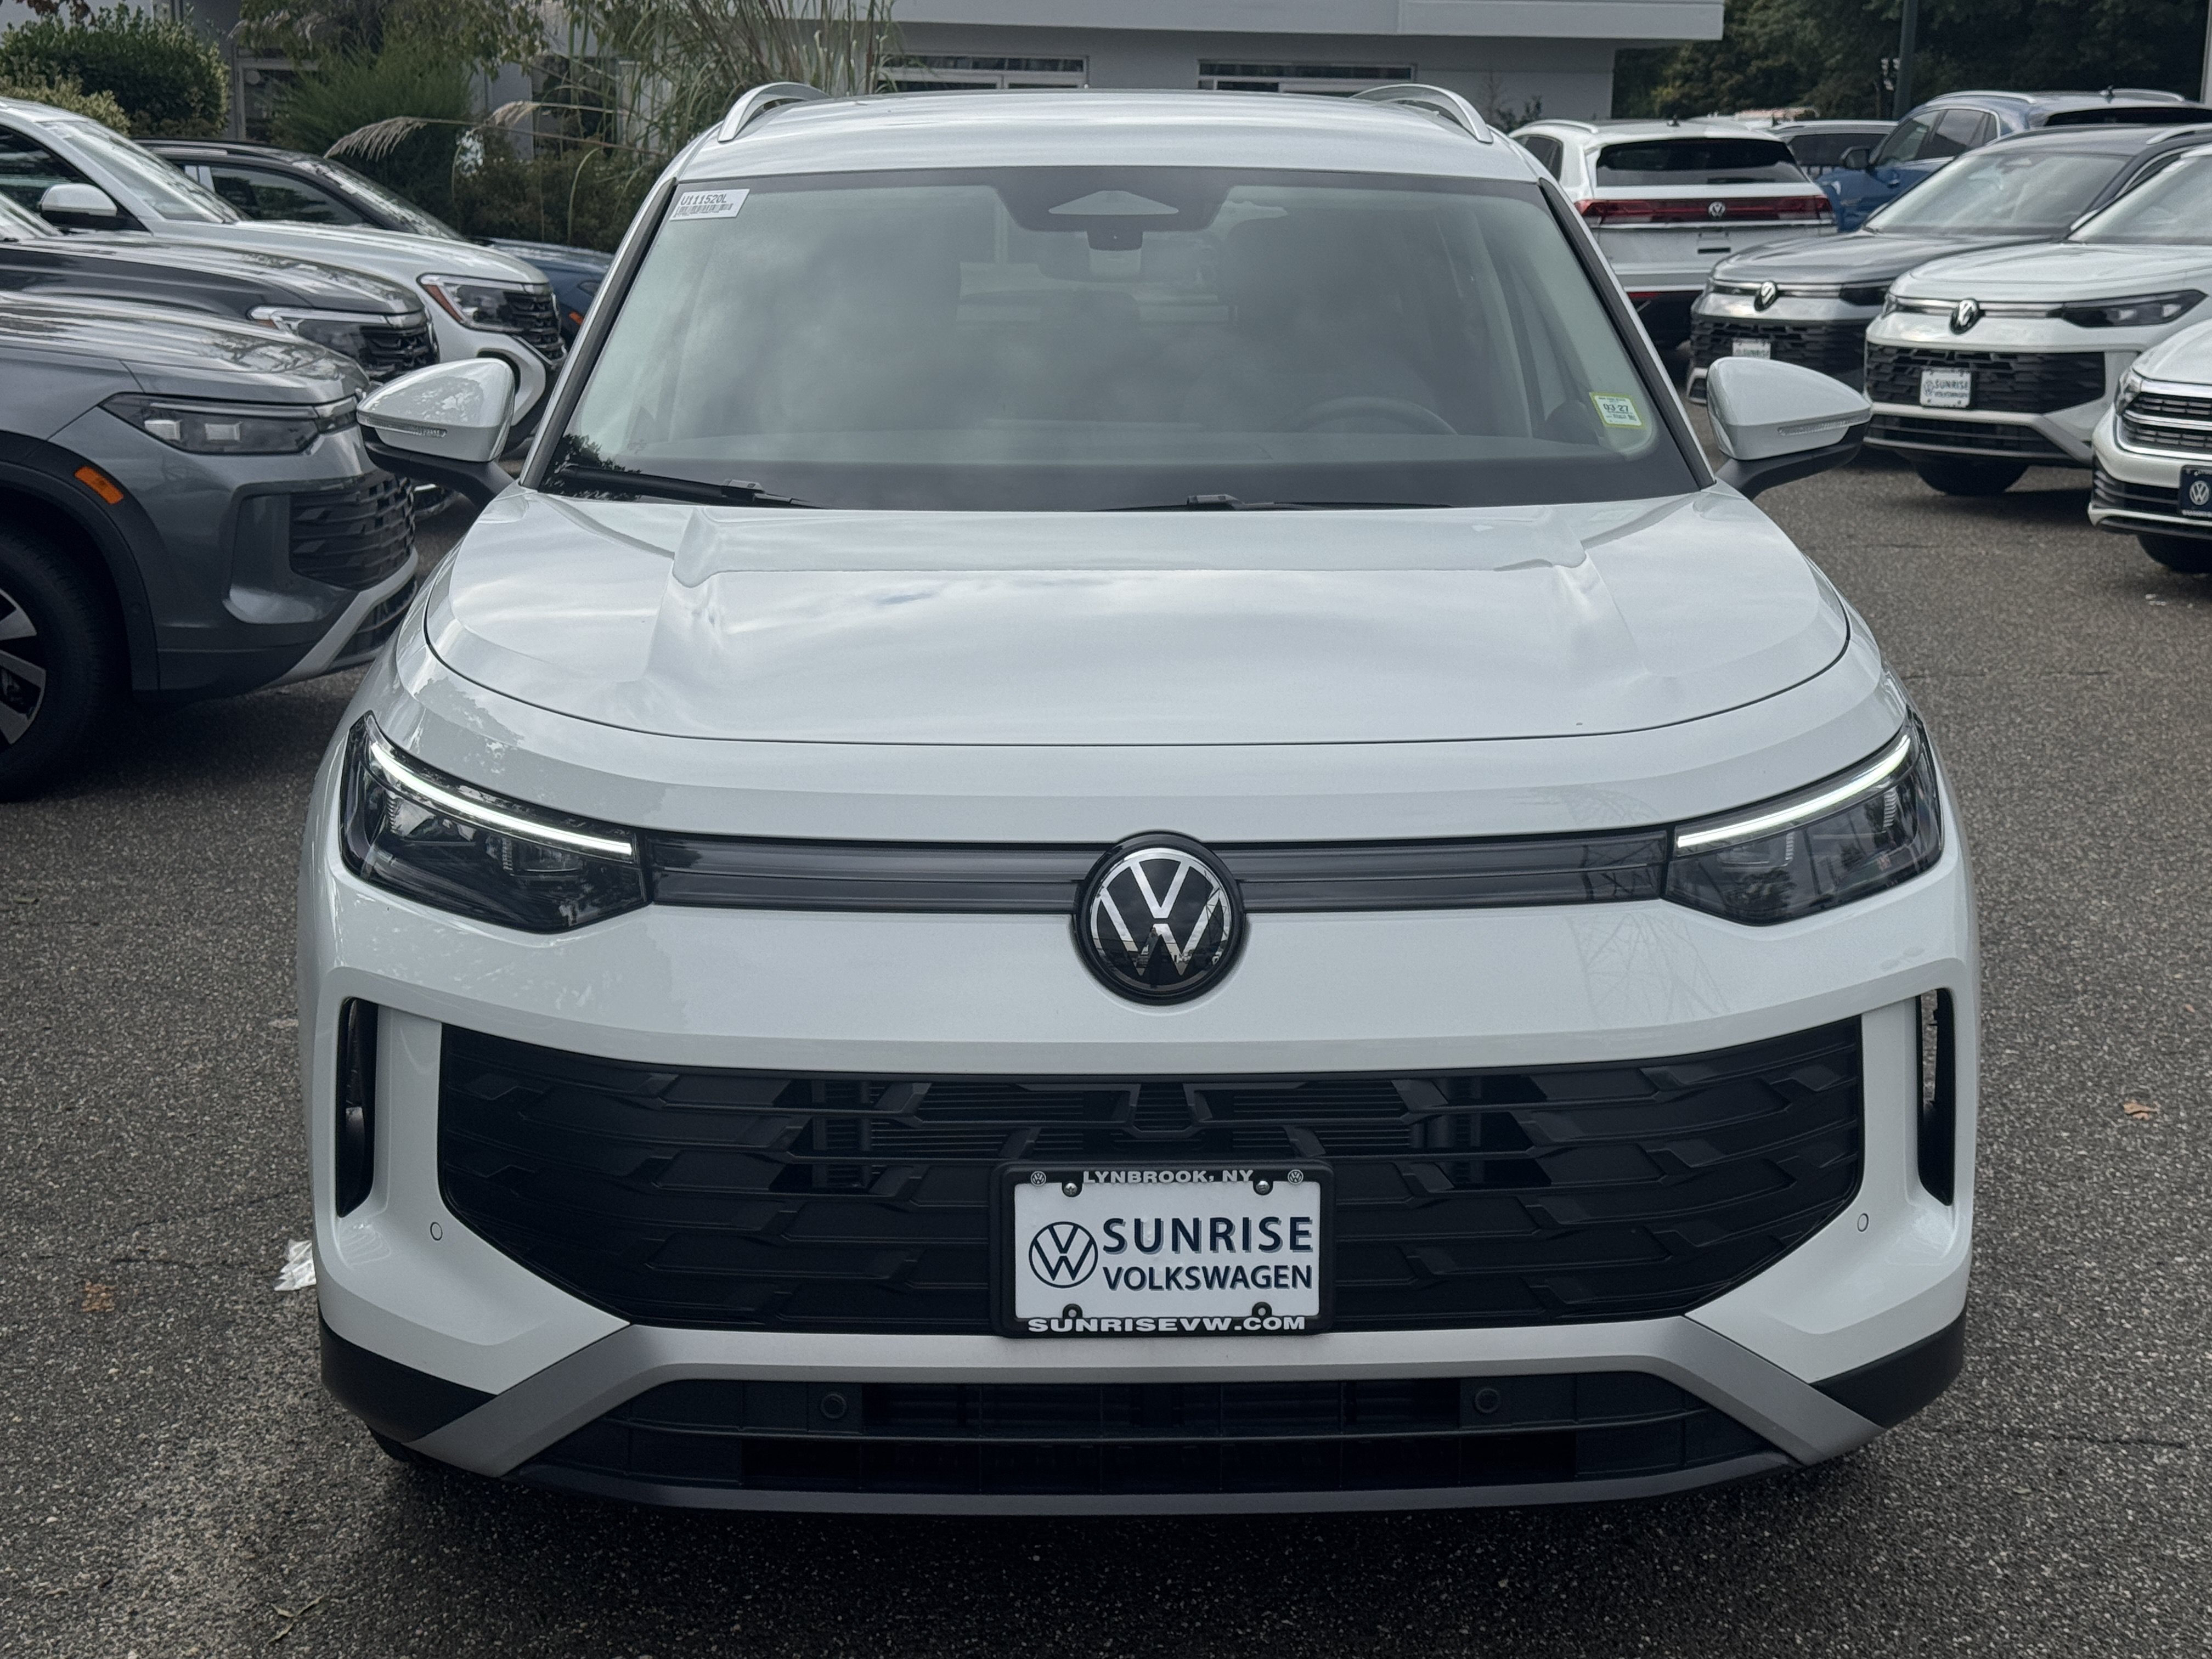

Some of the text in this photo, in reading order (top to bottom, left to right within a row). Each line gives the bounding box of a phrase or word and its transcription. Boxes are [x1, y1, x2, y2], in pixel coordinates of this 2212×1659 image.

[681, 194, 727, 205] U111520L
[1092, 850, 1229, 986] VW
[1083, 1170, 1253, 1183] LYNBROOK, NY
[1103, 1216, 1313, 1254] SUNRISE
[1030, 1222, 1097, 1287] VW
[1102, 1265, 1312, 1291] VOLKSWAGEN
[1028, 1317, 1305, 1332] SUNRISEVW.COM
